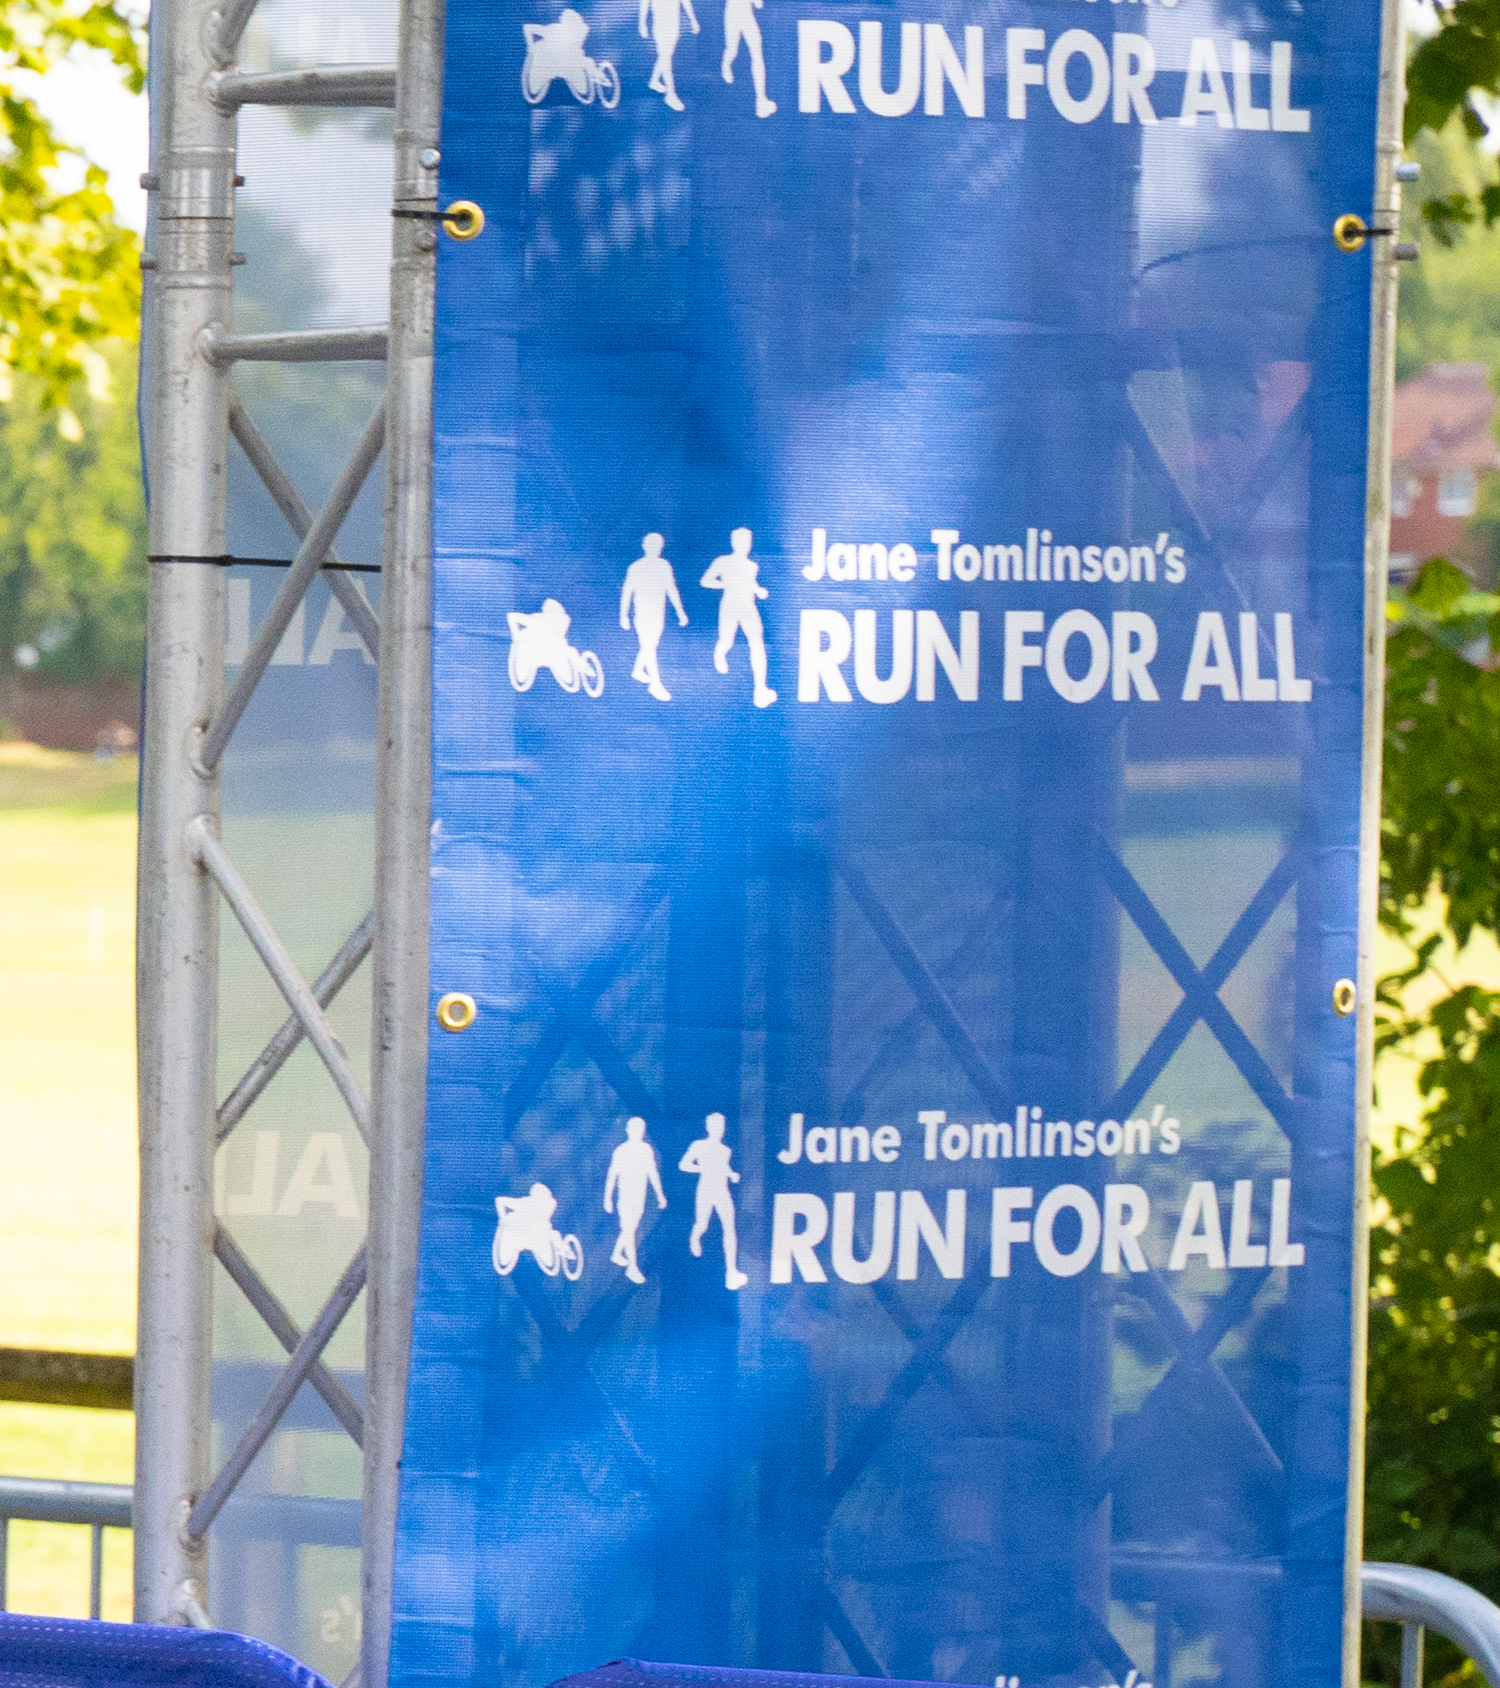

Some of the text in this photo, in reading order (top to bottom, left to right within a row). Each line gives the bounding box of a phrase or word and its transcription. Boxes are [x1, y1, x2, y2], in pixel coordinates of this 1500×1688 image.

[798, 18, 1311, 132] RUN FOR ALL
[802, 527, 1187, 583] Jane Tomlinson's
[798, 608, 1313, 704] RUN FOR ALL
[778, 1104, 1181, 1164] Jane Tomlinson's
[770, 1178, 1306, 1284] RUN FOR ALL
